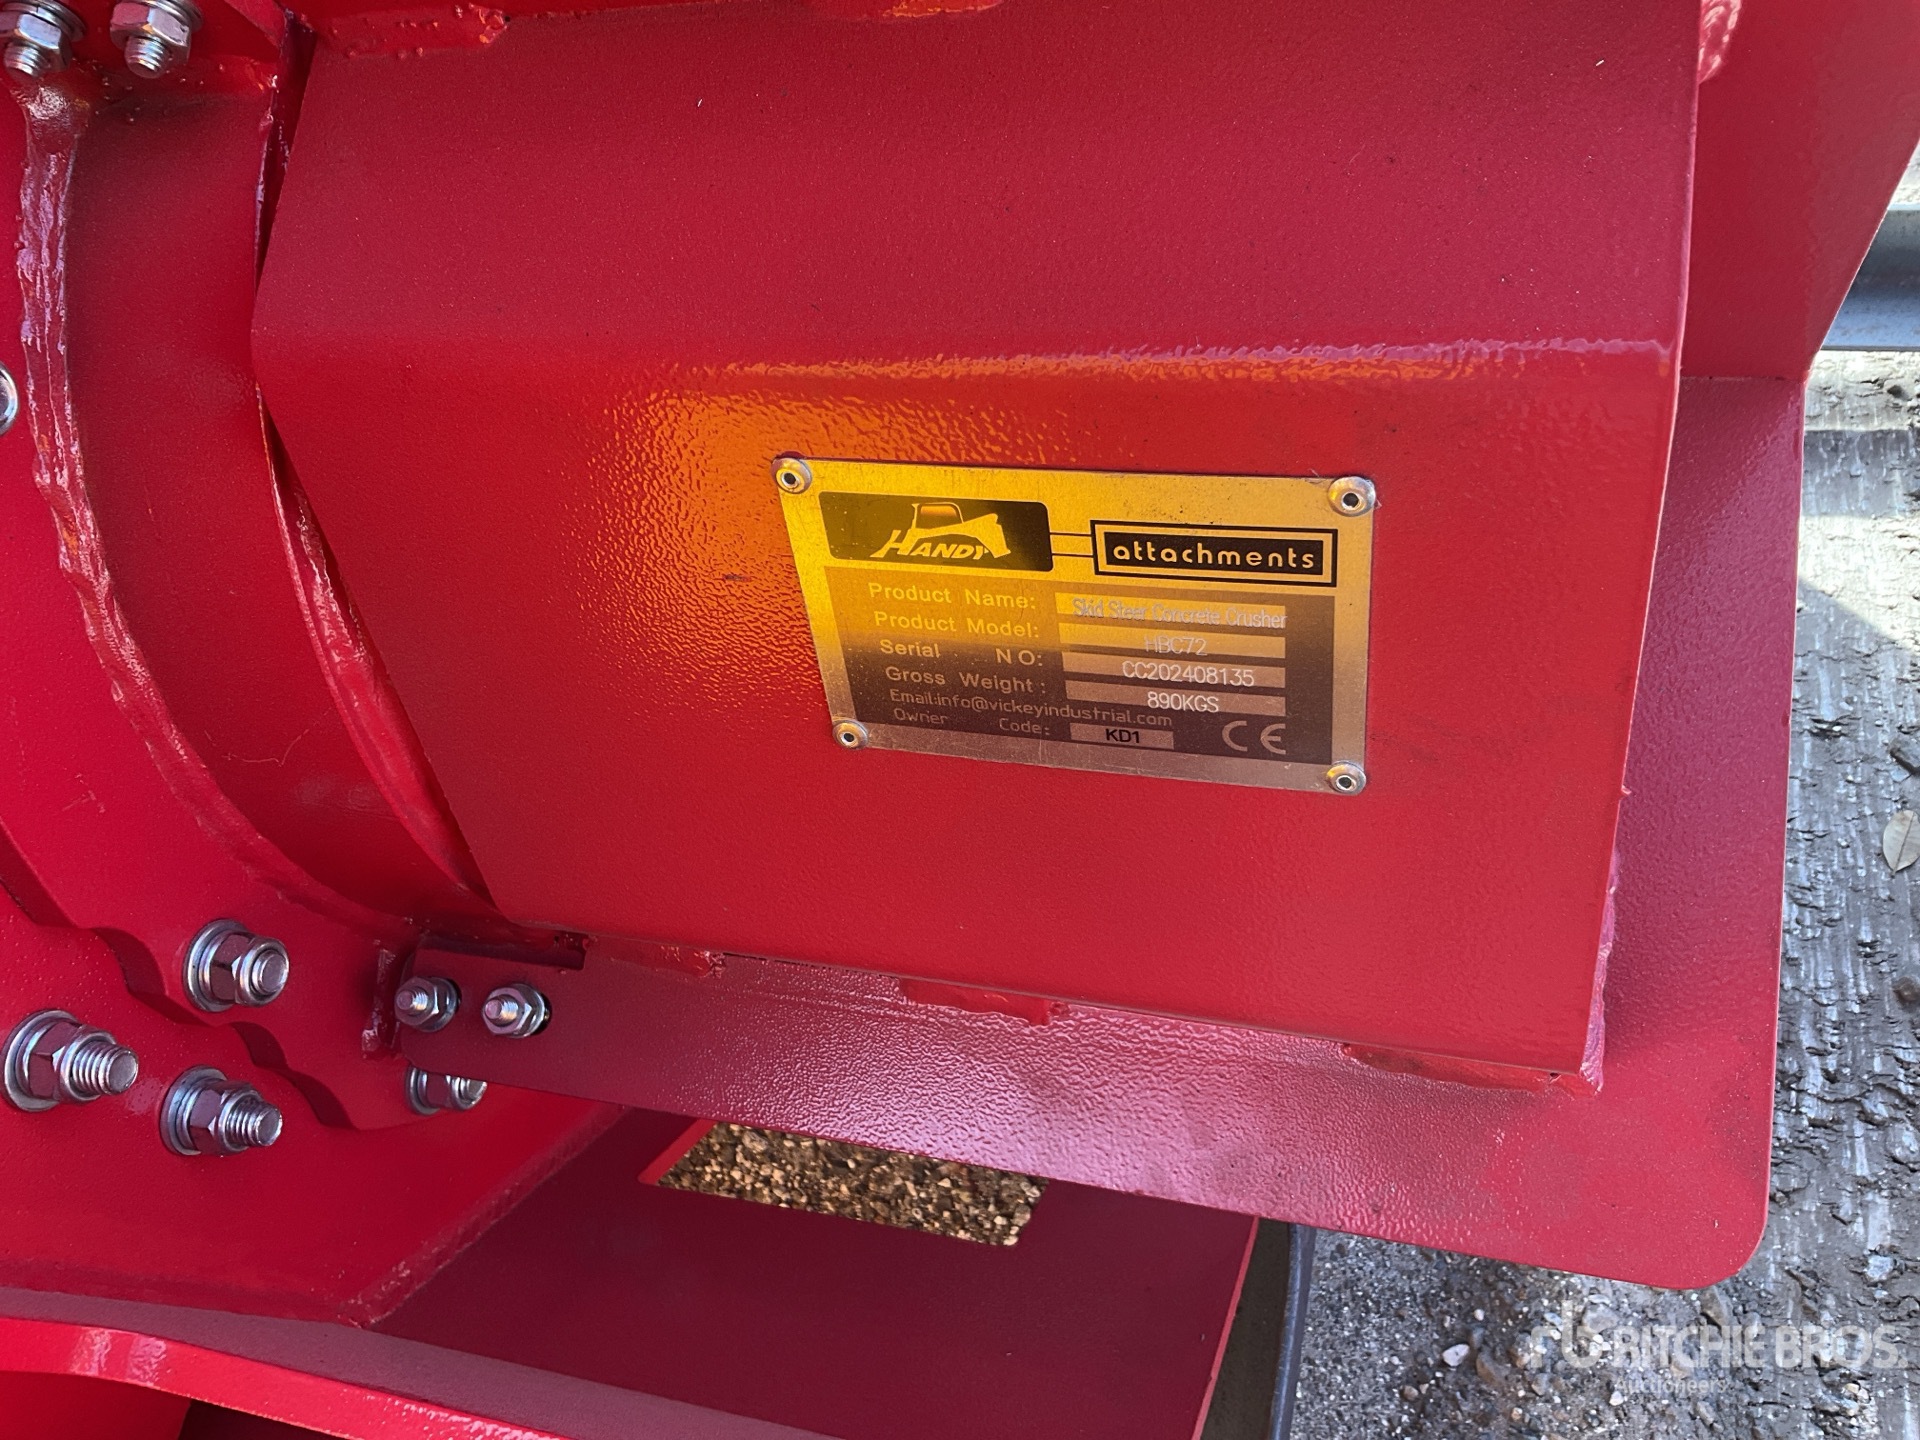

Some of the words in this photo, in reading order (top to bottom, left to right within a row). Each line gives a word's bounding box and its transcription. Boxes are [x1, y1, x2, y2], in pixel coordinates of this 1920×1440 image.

[870, 529, 989, 561] HANDY
[1112, 541, 1315, 570] attachments
[868, 582, 952, 604] Product
[965, 588, 1036, 610] Name:
[1072, 597, 1104, 619] Skid
[1108, 600, 1147, 621] Steer
[1152, 603, 1221, 625] Concrete
[1226, 607, 1288, 629] Crusher
[874, 610, 957, 632] Product
[966, 617, 1039, 638] Model:
[1144, 635, 1208, 656] HBC72
[880, 639, 941, 658] Serial
[1122, 660, 1255, 688] CC202408135
[886, 666, 946, 685] Gross
[1147, 691, 1219, 713] 890KGS
[893, 708, 948, 725] Owner
[999, 717, 1050, 736] Code:
[1105, 728, 1140, 744] KD1
